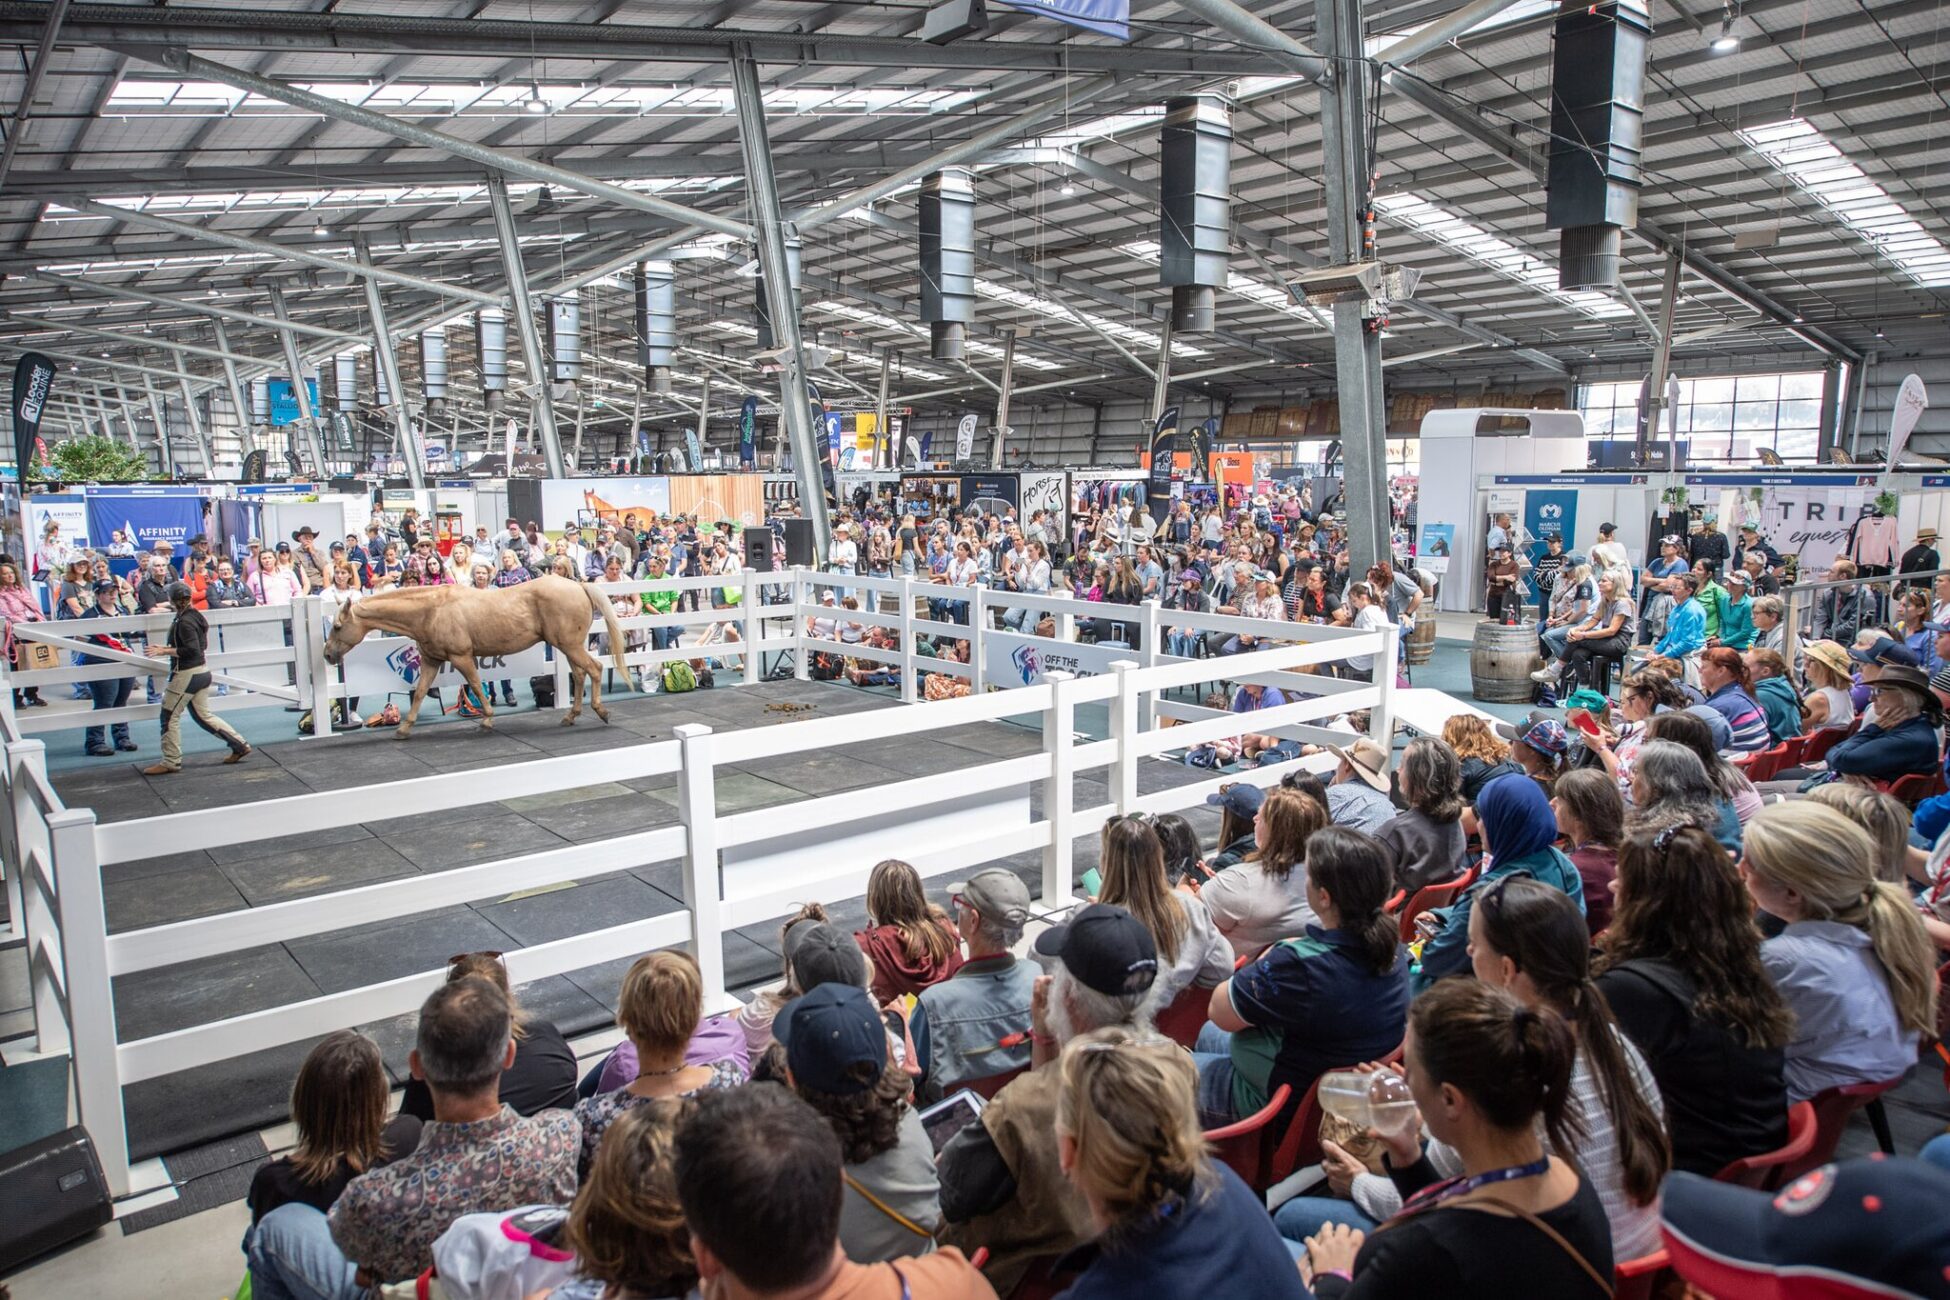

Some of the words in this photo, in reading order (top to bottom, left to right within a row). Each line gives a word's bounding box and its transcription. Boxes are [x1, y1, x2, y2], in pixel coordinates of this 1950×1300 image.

[34, 368, 51, 405] EQUINE
[139, 527, 187, 536] AFFINITY
[1044, 654, 1061, 664] OFF
[1062, 656, 1079, 668] THE
